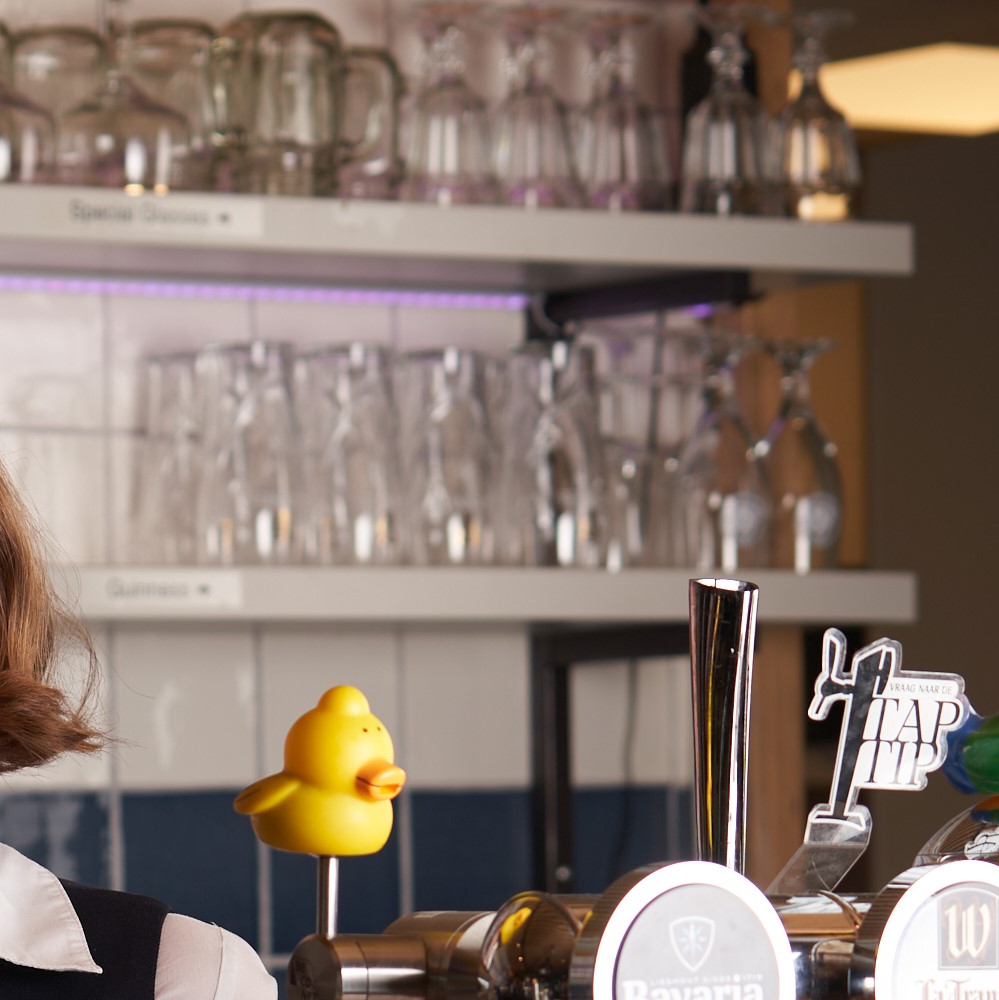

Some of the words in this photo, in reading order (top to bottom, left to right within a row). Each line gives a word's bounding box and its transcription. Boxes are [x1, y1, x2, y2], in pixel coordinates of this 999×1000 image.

[890, 682, 916, 692] VRAAG
[919, 684, 939, 694] NAAR
[942, 685, 953, 694] DE
[864, 698, 961, 743] TAP
[943, 902, 992, 959] W
